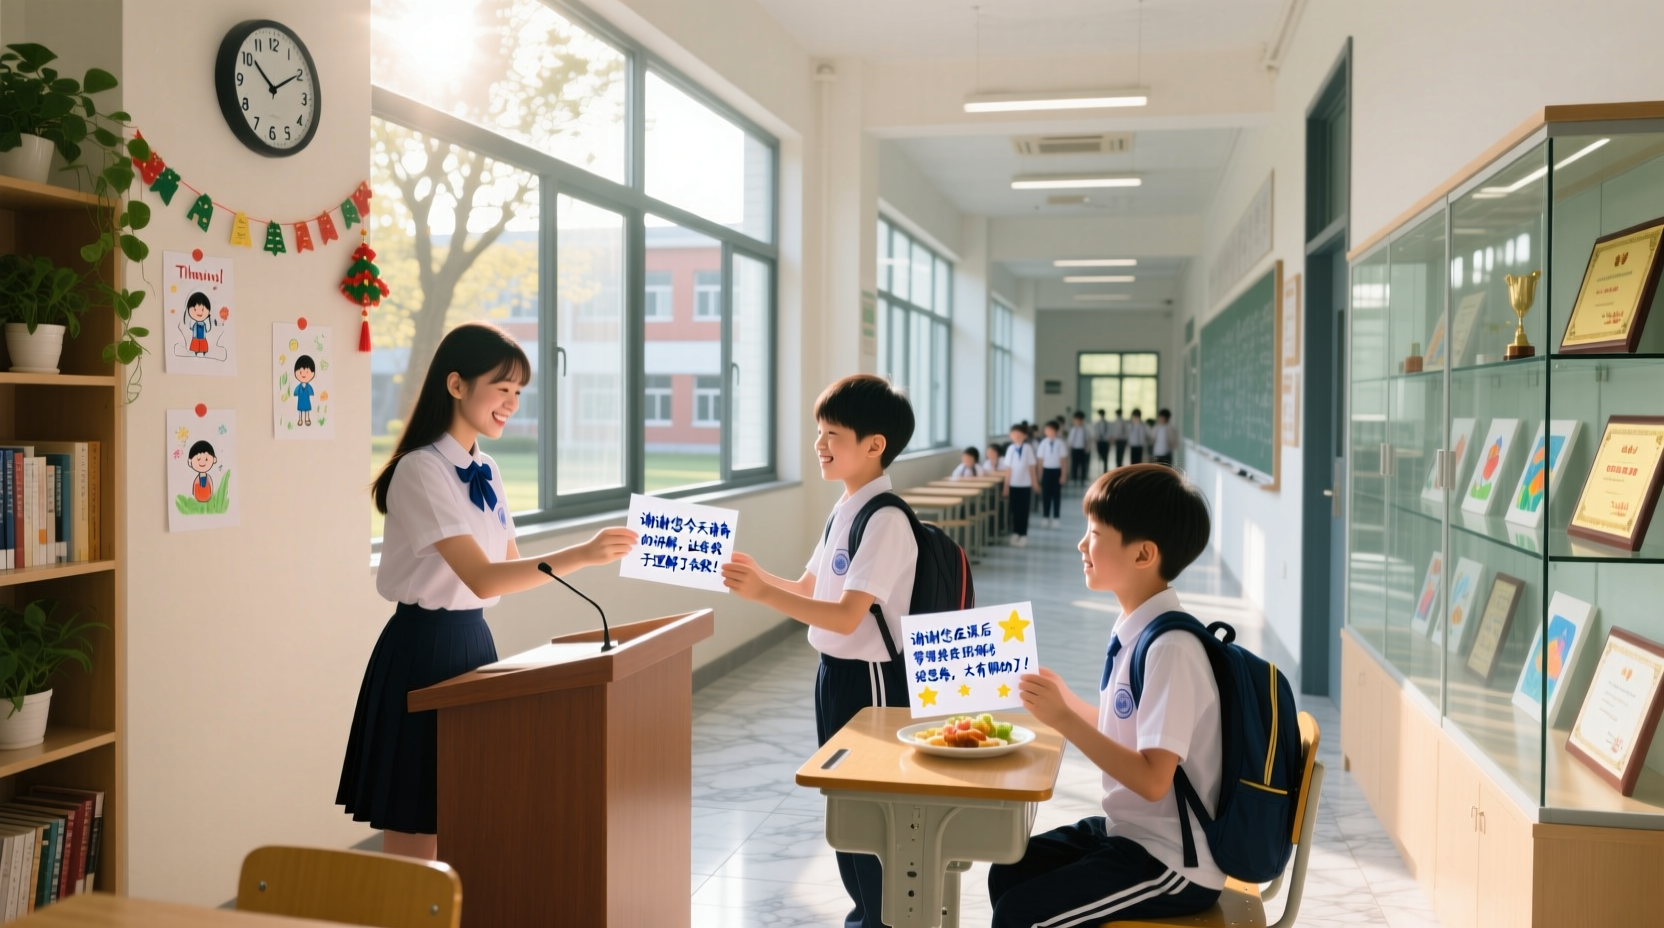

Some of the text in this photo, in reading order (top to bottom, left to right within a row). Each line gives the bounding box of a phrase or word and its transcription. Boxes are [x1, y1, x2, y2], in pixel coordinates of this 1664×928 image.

[254, 38, 262, 52] 11
[269, 37, 280, 52] 12
[241, 51, 253, 67] 10
[287, 47, 291, 61] 1
[236, 72, 244, 86] 9
[296, 68, 304, 82] 2
[241, 97, 249, 111] 8
[301, 92, 308, 106] 3
[253, 116, 260, 130] 7
[296, 114, 303, 126] 4
[268, 125, 277, 140] 6
[284, 126, 291, 140] 5
